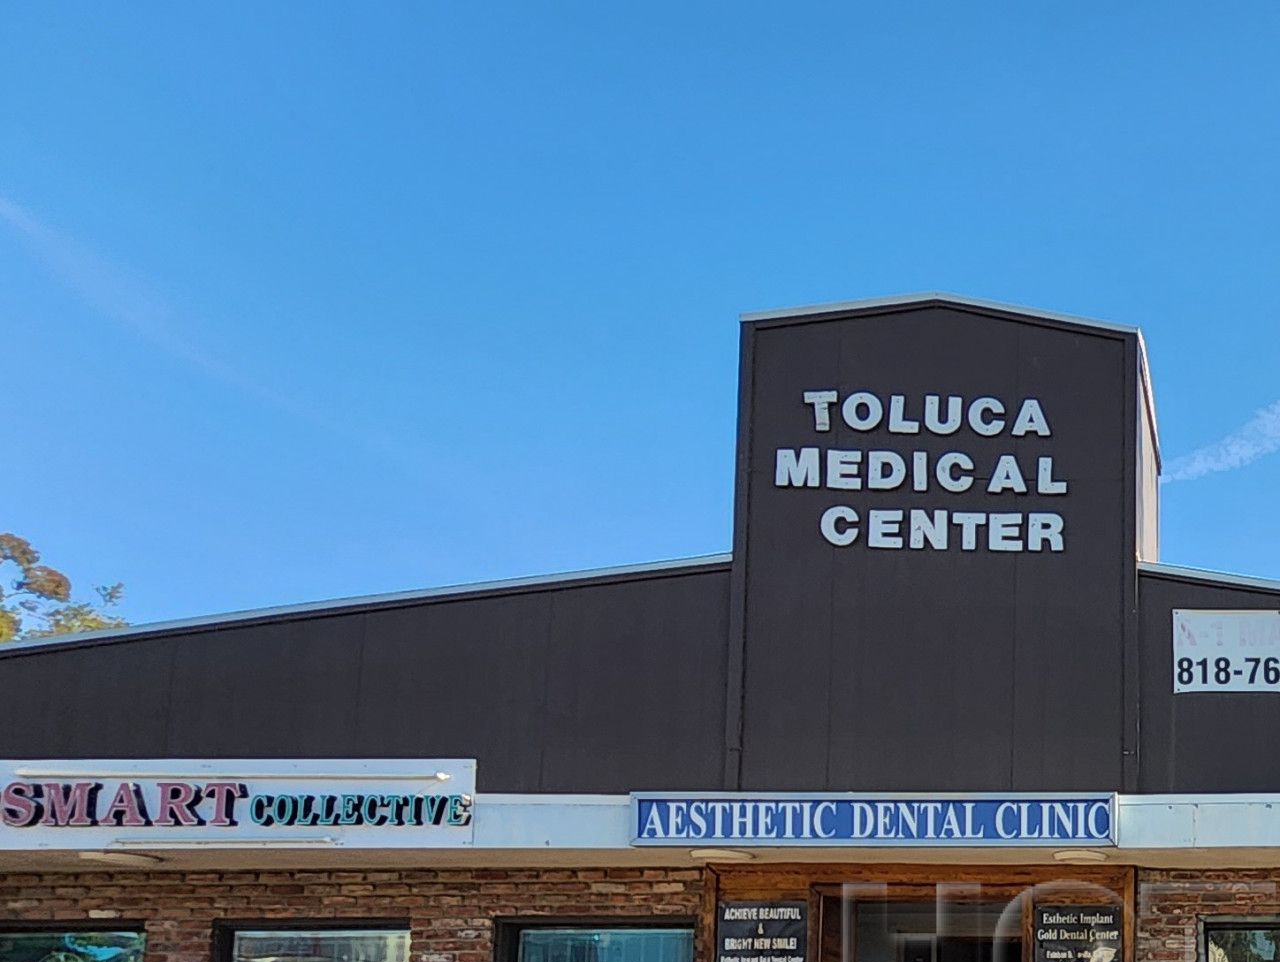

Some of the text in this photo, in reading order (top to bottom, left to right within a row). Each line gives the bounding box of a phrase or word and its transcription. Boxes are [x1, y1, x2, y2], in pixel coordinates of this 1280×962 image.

[803, 390, 1051, 436] TOLUCA
[775, 447, 1067, 494] MEDICAL
[820, 505, 1065, 551] CENTER
[0, 782, 472, 827] SMART COLLECTIVE
[640, 801, 1110, 839] AESTHETIC DENTAL CLINIC
[724, 907, 801, 920] ACHIEVE BEAUTIFUL
[1042, 912, 1113, 927] Esthetic Implant
[724, 938, 753, 950] BRIGHT
[754, 938, 771, 950] NEW
[1037, 928, 1119, 942] Gold Dental Center
